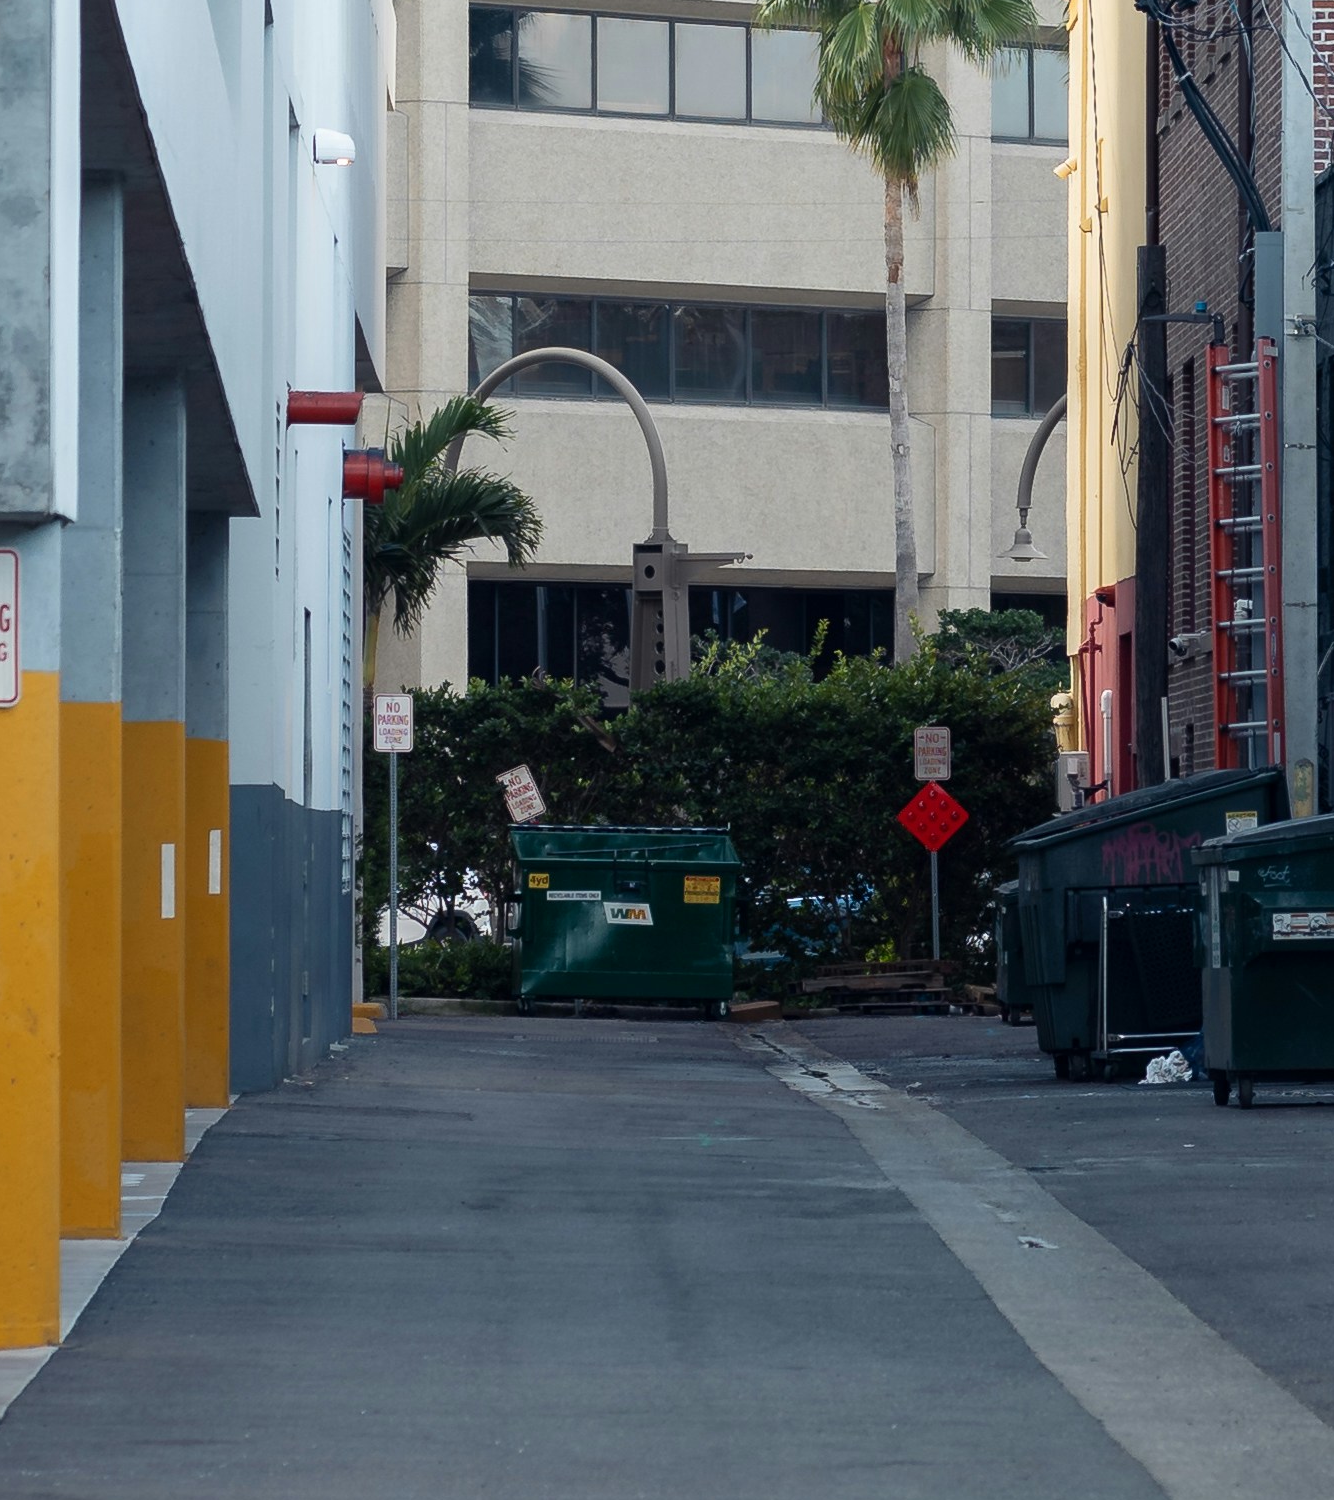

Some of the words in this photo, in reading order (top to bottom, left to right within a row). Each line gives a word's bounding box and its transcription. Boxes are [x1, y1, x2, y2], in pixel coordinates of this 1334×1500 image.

[386, 702, 400, 714] NO
[378, 714, 409, 726] PARKING
[379, 728, 409, 736] LOADING
[384, 736, 403, 744] ZONE
[925, 733, 940, 743] NO
[918, 746, 947, 757] PARKING
[508, 775, 522, 788] NO
[505, 782, 534, 801] PARKING
[530, 875, 548, 886] 4yd
[610, 907, 646, 920] WM
